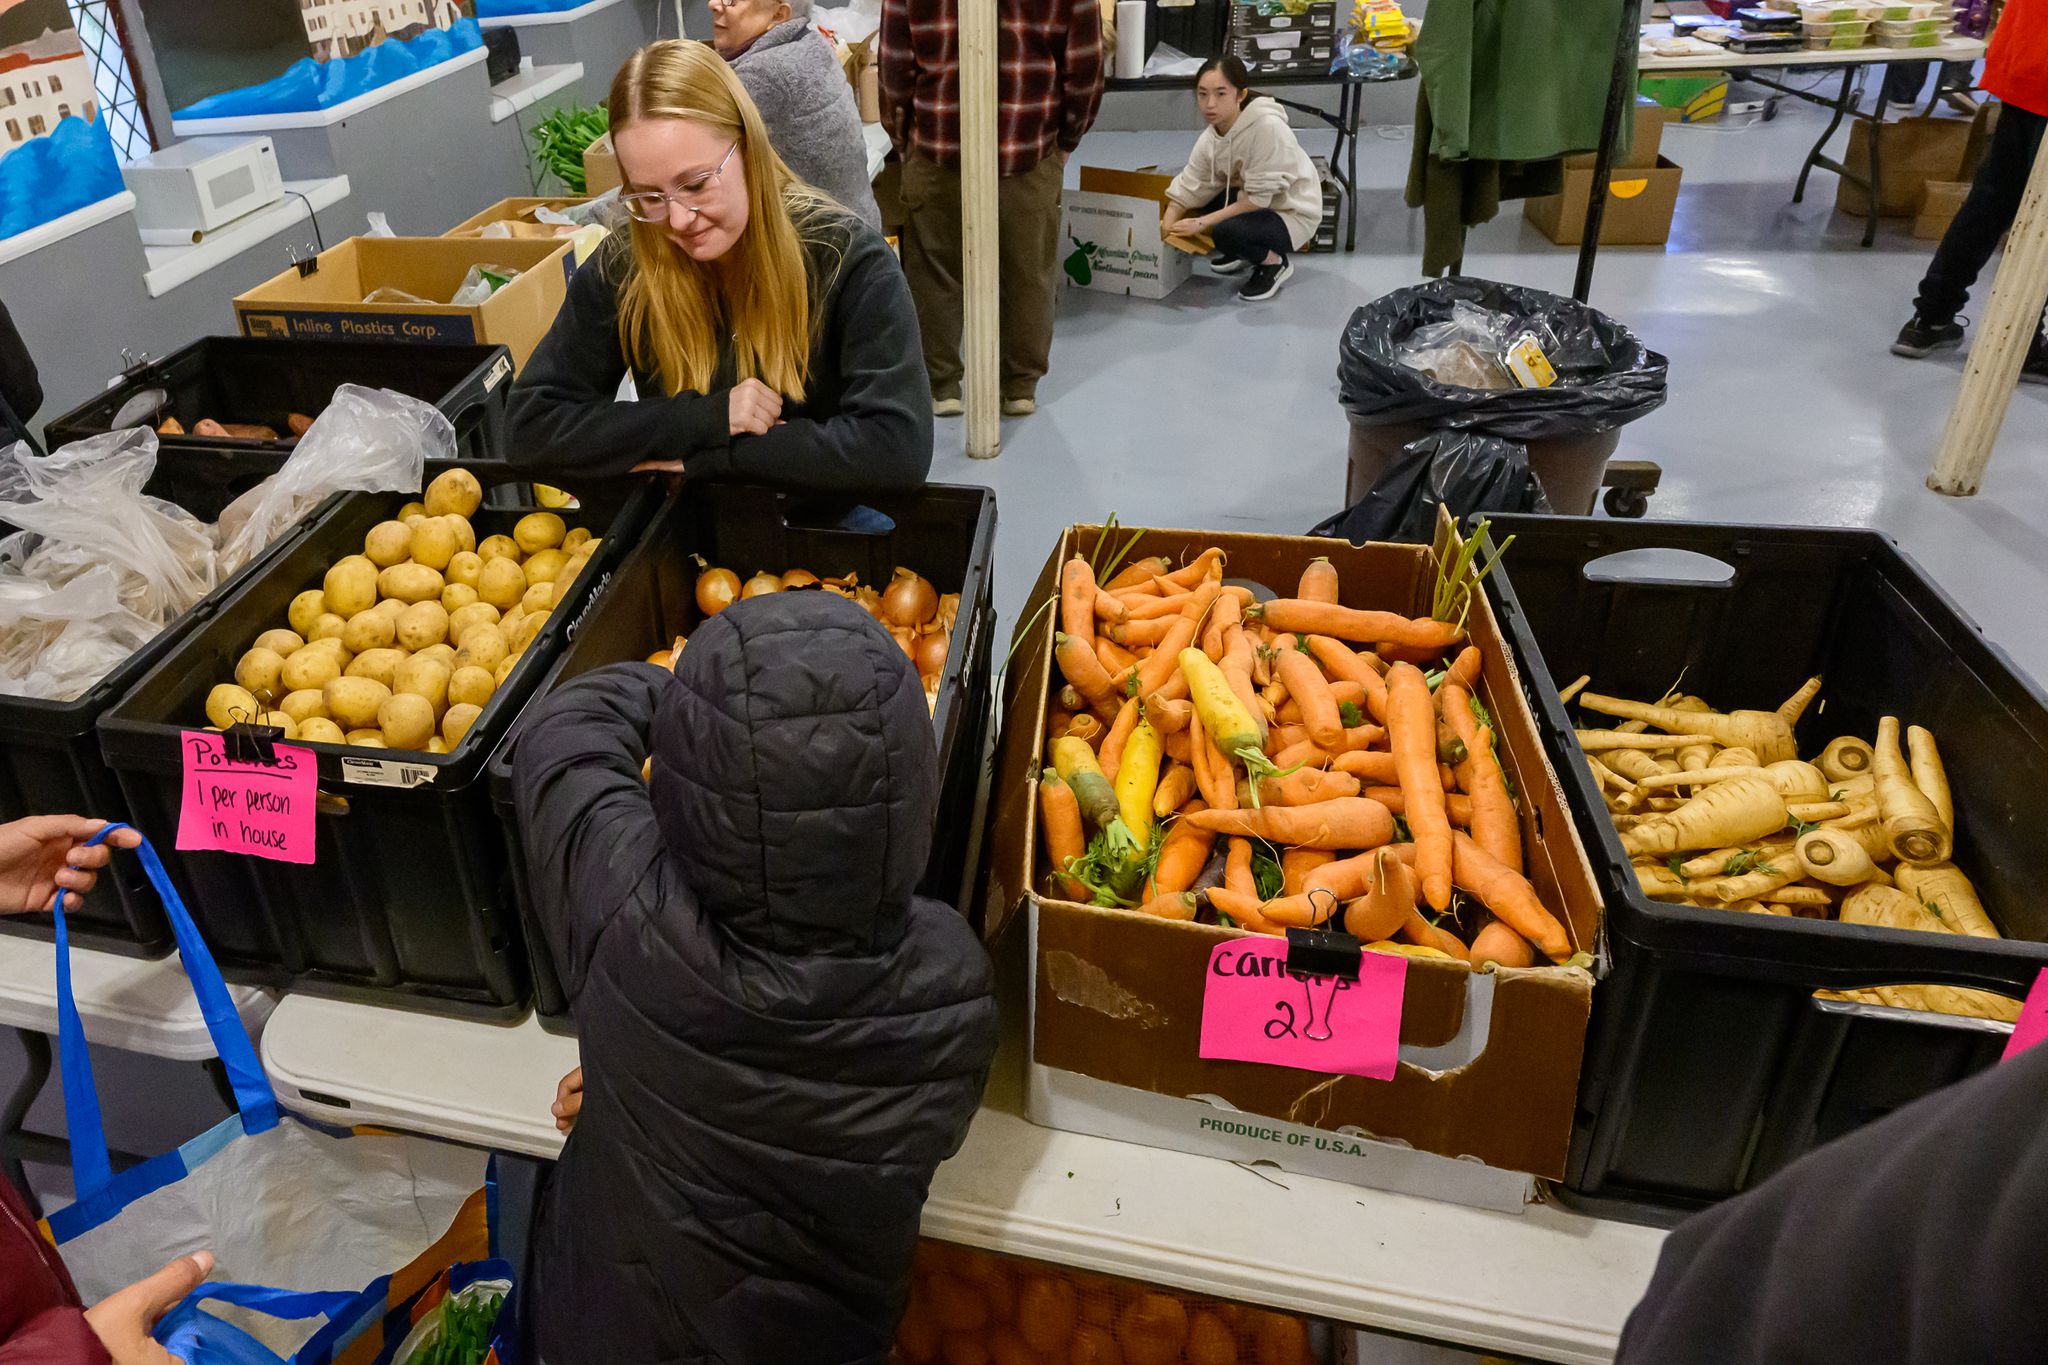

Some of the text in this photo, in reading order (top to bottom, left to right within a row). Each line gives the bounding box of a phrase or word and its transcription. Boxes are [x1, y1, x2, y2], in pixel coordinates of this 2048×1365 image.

[293, 318, 333, 333] Inline
[341, 319, 395, 336] Plastics
[402, 321, 442, 339] Corp.
[211, 785, 237, 812] per
[246, 788, 290, 815] person
[211, 816, 288, 850] in house
[1264, 1000, 1298, 1040] 2
[1200, 1117, 1367, 1158] PRODUCE OF U.S.A.
